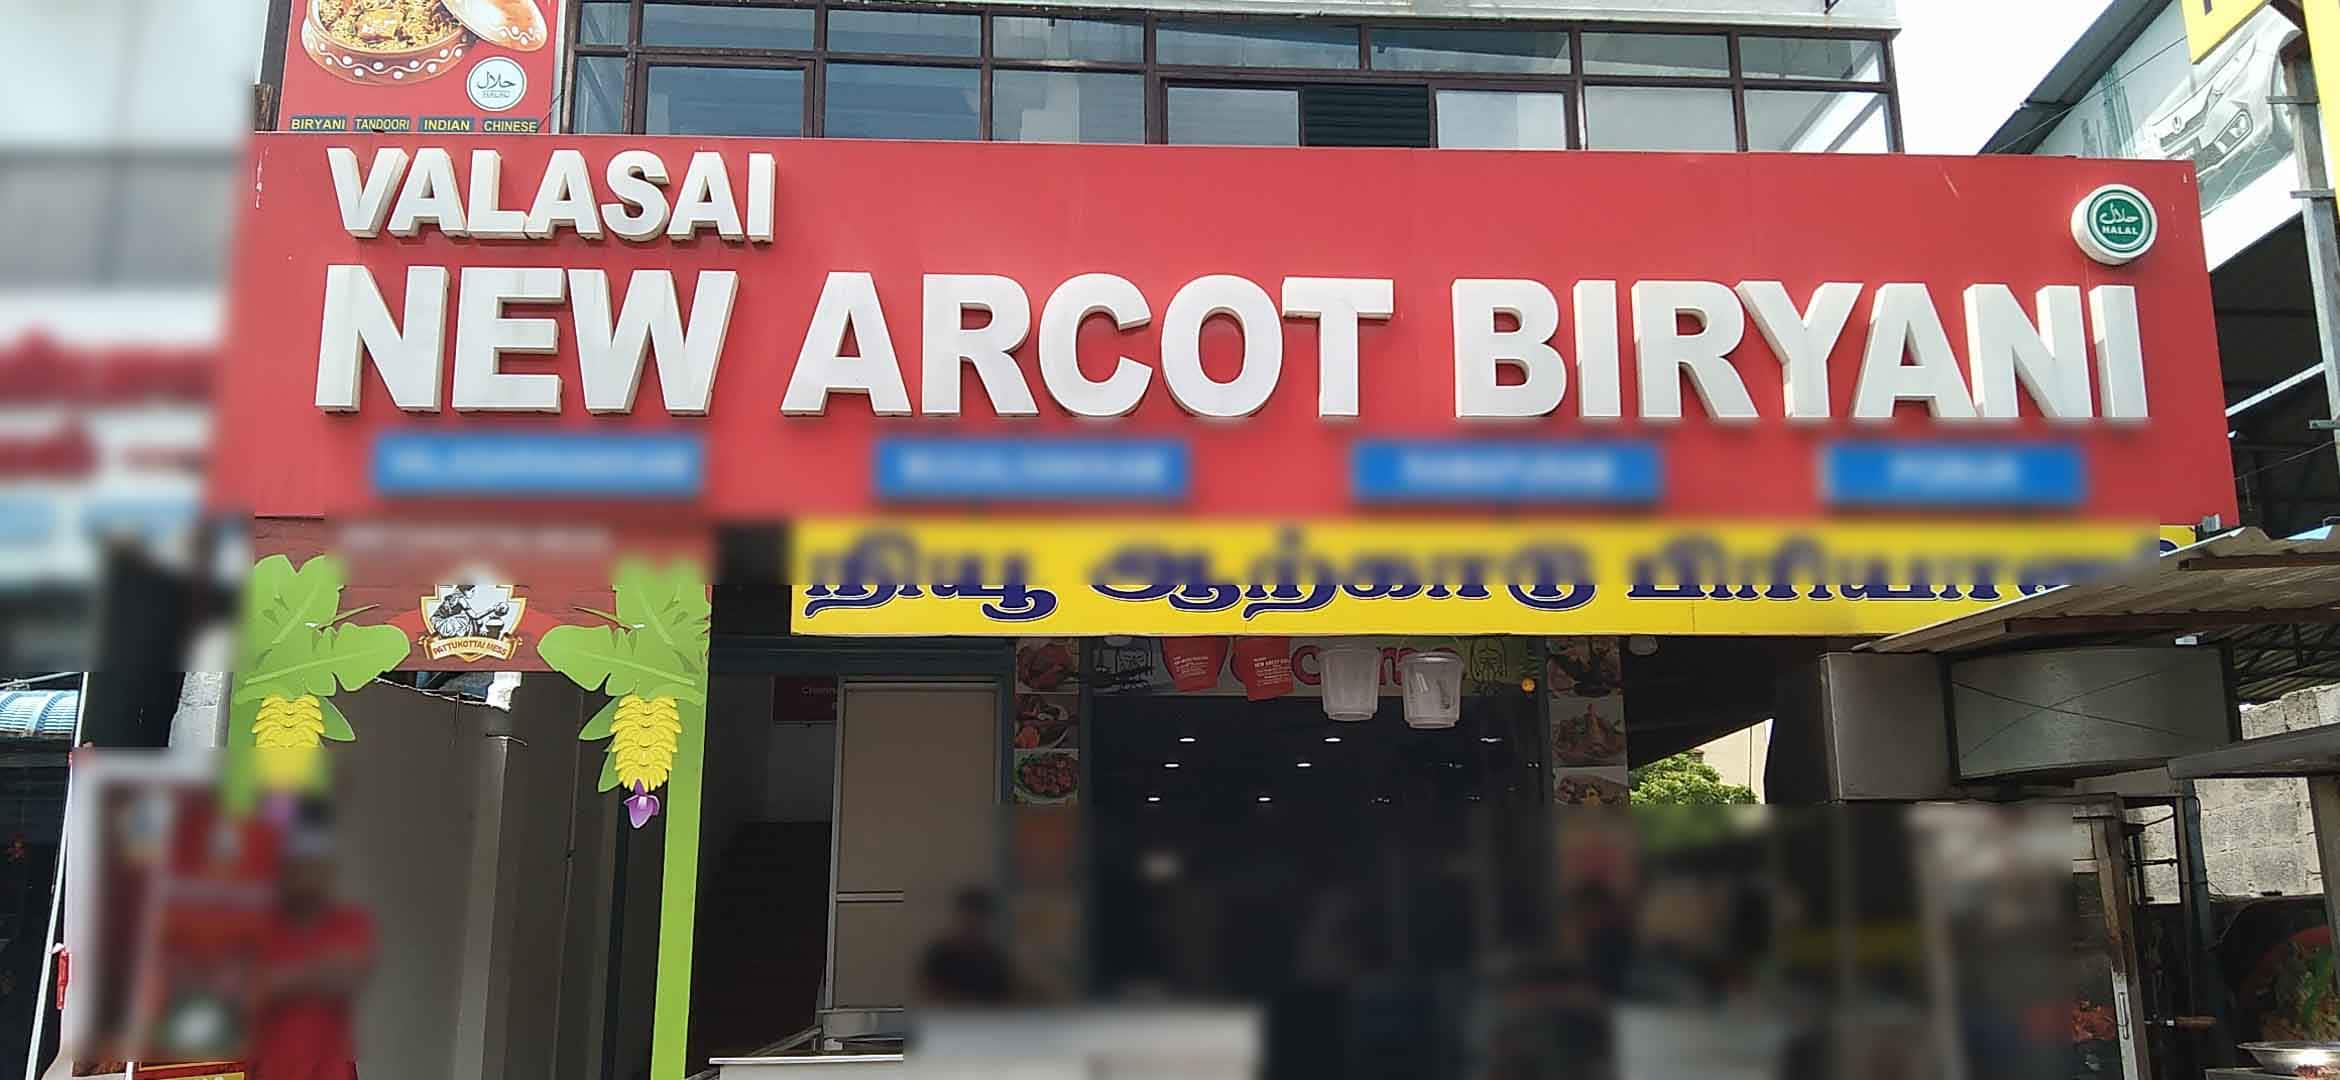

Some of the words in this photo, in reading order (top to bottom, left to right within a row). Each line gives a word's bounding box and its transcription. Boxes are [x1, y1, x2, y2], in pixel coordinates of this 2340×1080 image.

[291, 118, 346, 130] BIRYANI
[355, 118, 410, 131] TANDOORI
[424, 119, 470, 131] INDIAN
[483, 119, 538, 132] CHINESE
[326, 147, 777, 243] VALASAI
[2101, 226, 2139, 235] HALAL
[314, 264, 740, 416] NEW
[780, 270, 1395, 418] ARCOT
[1450, 278, 2150, 420] BIRYANI
[432, 638, 485, 655] PATTUKOTTAI
